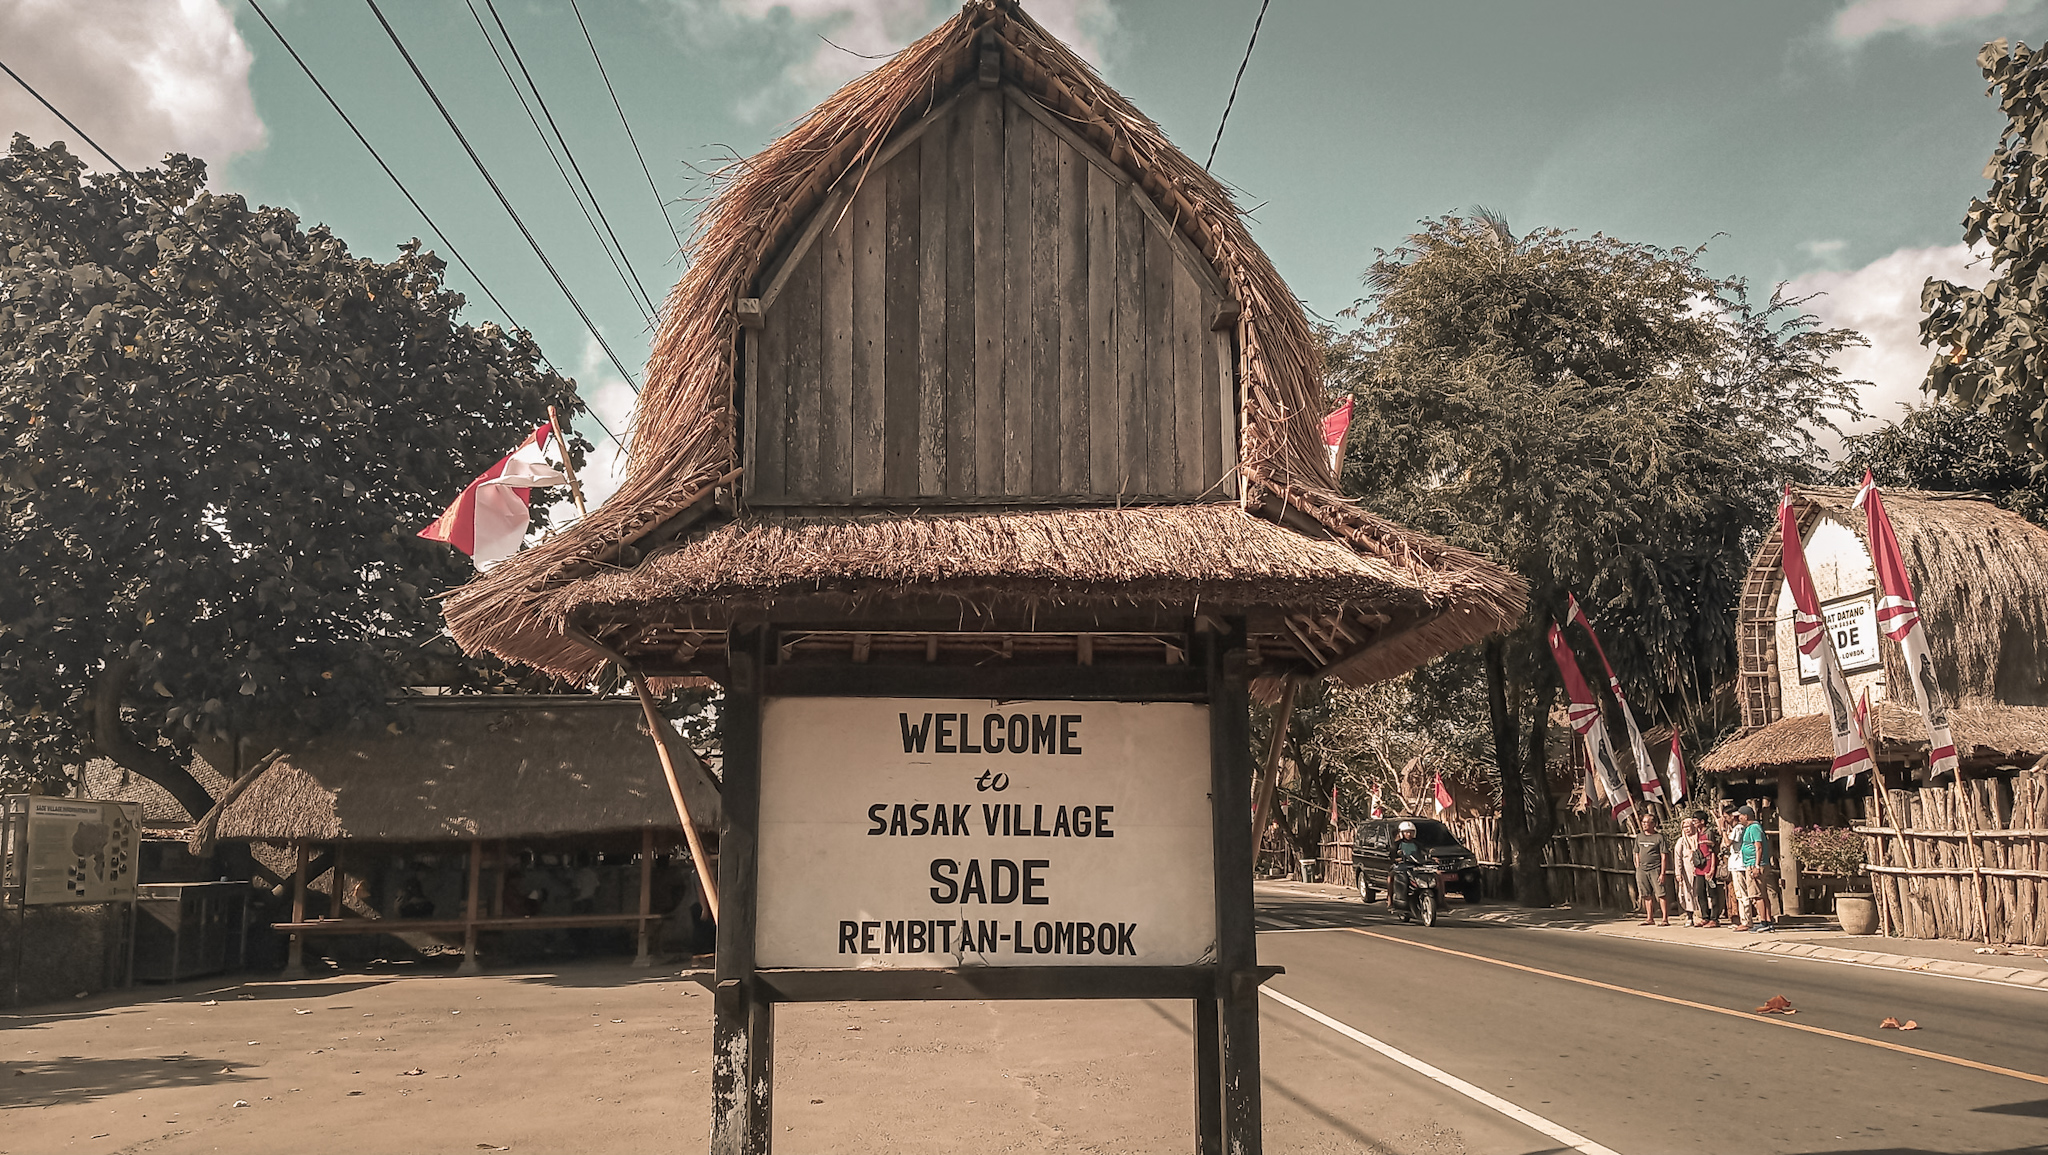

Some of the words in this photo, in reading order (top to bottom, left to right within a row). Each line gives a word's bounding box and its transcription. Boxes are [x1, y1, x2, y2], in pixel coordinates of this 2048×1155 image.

[1837, 606, 1864, 621] DATANG
[1838, 627, 1860, 649] DE
[899, 712, 1083, 755] WELCOME
[974, 769, 1010, 792] to
[867, 803, 972, 837] SASAK
[982, 804, 1115, 838] VILLAGE
[929, 858, 1051, 905] SADE
[838, 918, 1138, 956] REMBITAN-LOMBOK
